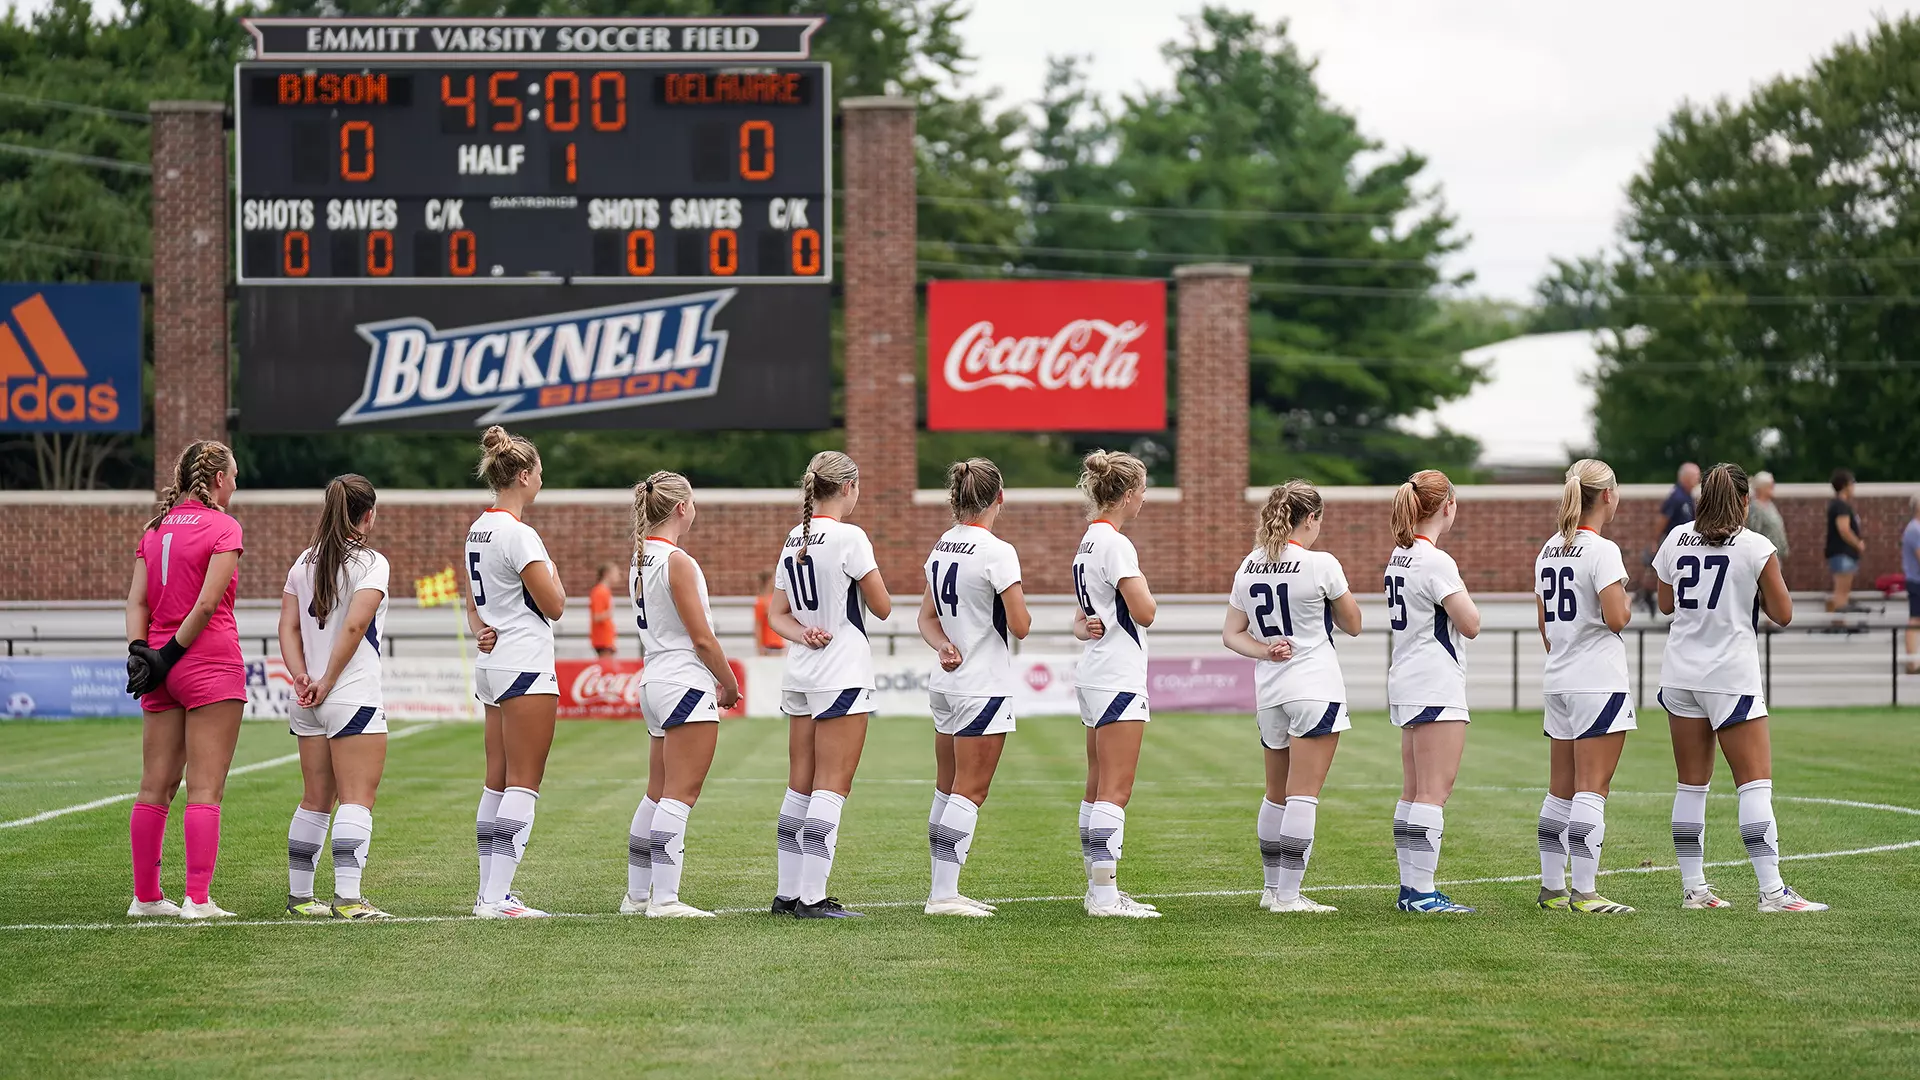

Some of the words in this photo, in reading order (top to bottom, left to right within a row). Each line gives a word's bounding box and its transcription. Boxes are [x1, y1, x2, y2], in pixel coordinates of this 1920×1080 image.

[307, 27, 418, 50] EMMITT
[431, 27, 546, 50] VARSITY
[557, 27, 671, 50] SOCCER
[682, 27, 759, 50] FIELD
[278, 73, 388, 105] BISON
[441, 71, 626, 131] 45:00
[665, 73, 801, 104] DELAWARE
[340, 121, 374, 181] 0
[457, 144, 525, 174] HALF
[566, 142, 577, 183] 1
[739, 120, 774, 180] 0
[244, 199, 314, 230] SHOTS
[326, 199, 398, 230] SAVES
[425, 199, 464, 231] C/K
[490, 196, 578, 209] DAKTRONICS
[588, 197, 660, 229] SHOTS
[670, 197, 742, 229] SAVES
[768, 198, 809, 230] C/K
[284, 230, 309, 277] 0
[367, 230, 393, 277] 0
[450, 230, 476, 277] 0
[627, 229, 655, 276] 0
[710, 229, 738, 276] 0
[792, 229, 820, 276] 0
[373, 304, 715, 407] BUCKNELL
[943, 318, 1149, 392] Coca-Cola
[538, 368, 699, 407] BISON
[161, 514, 202, 525] CKNELL
[161, 532, 174, 586] 1
[469, 552, 486, 606] 5
[783, 554, 820, 611] 10
[1244, 560, 1301, 575] BUCKNELL
[1676, 555, 1730, 610] 27
[634, 575, 648, 629] 9
[931, 560, 959, 617] 14
[1249, 582, 1294, 637] 21
[1384, 575, 1408, 631] 25
[1541, 566, 1577, 622] 26
